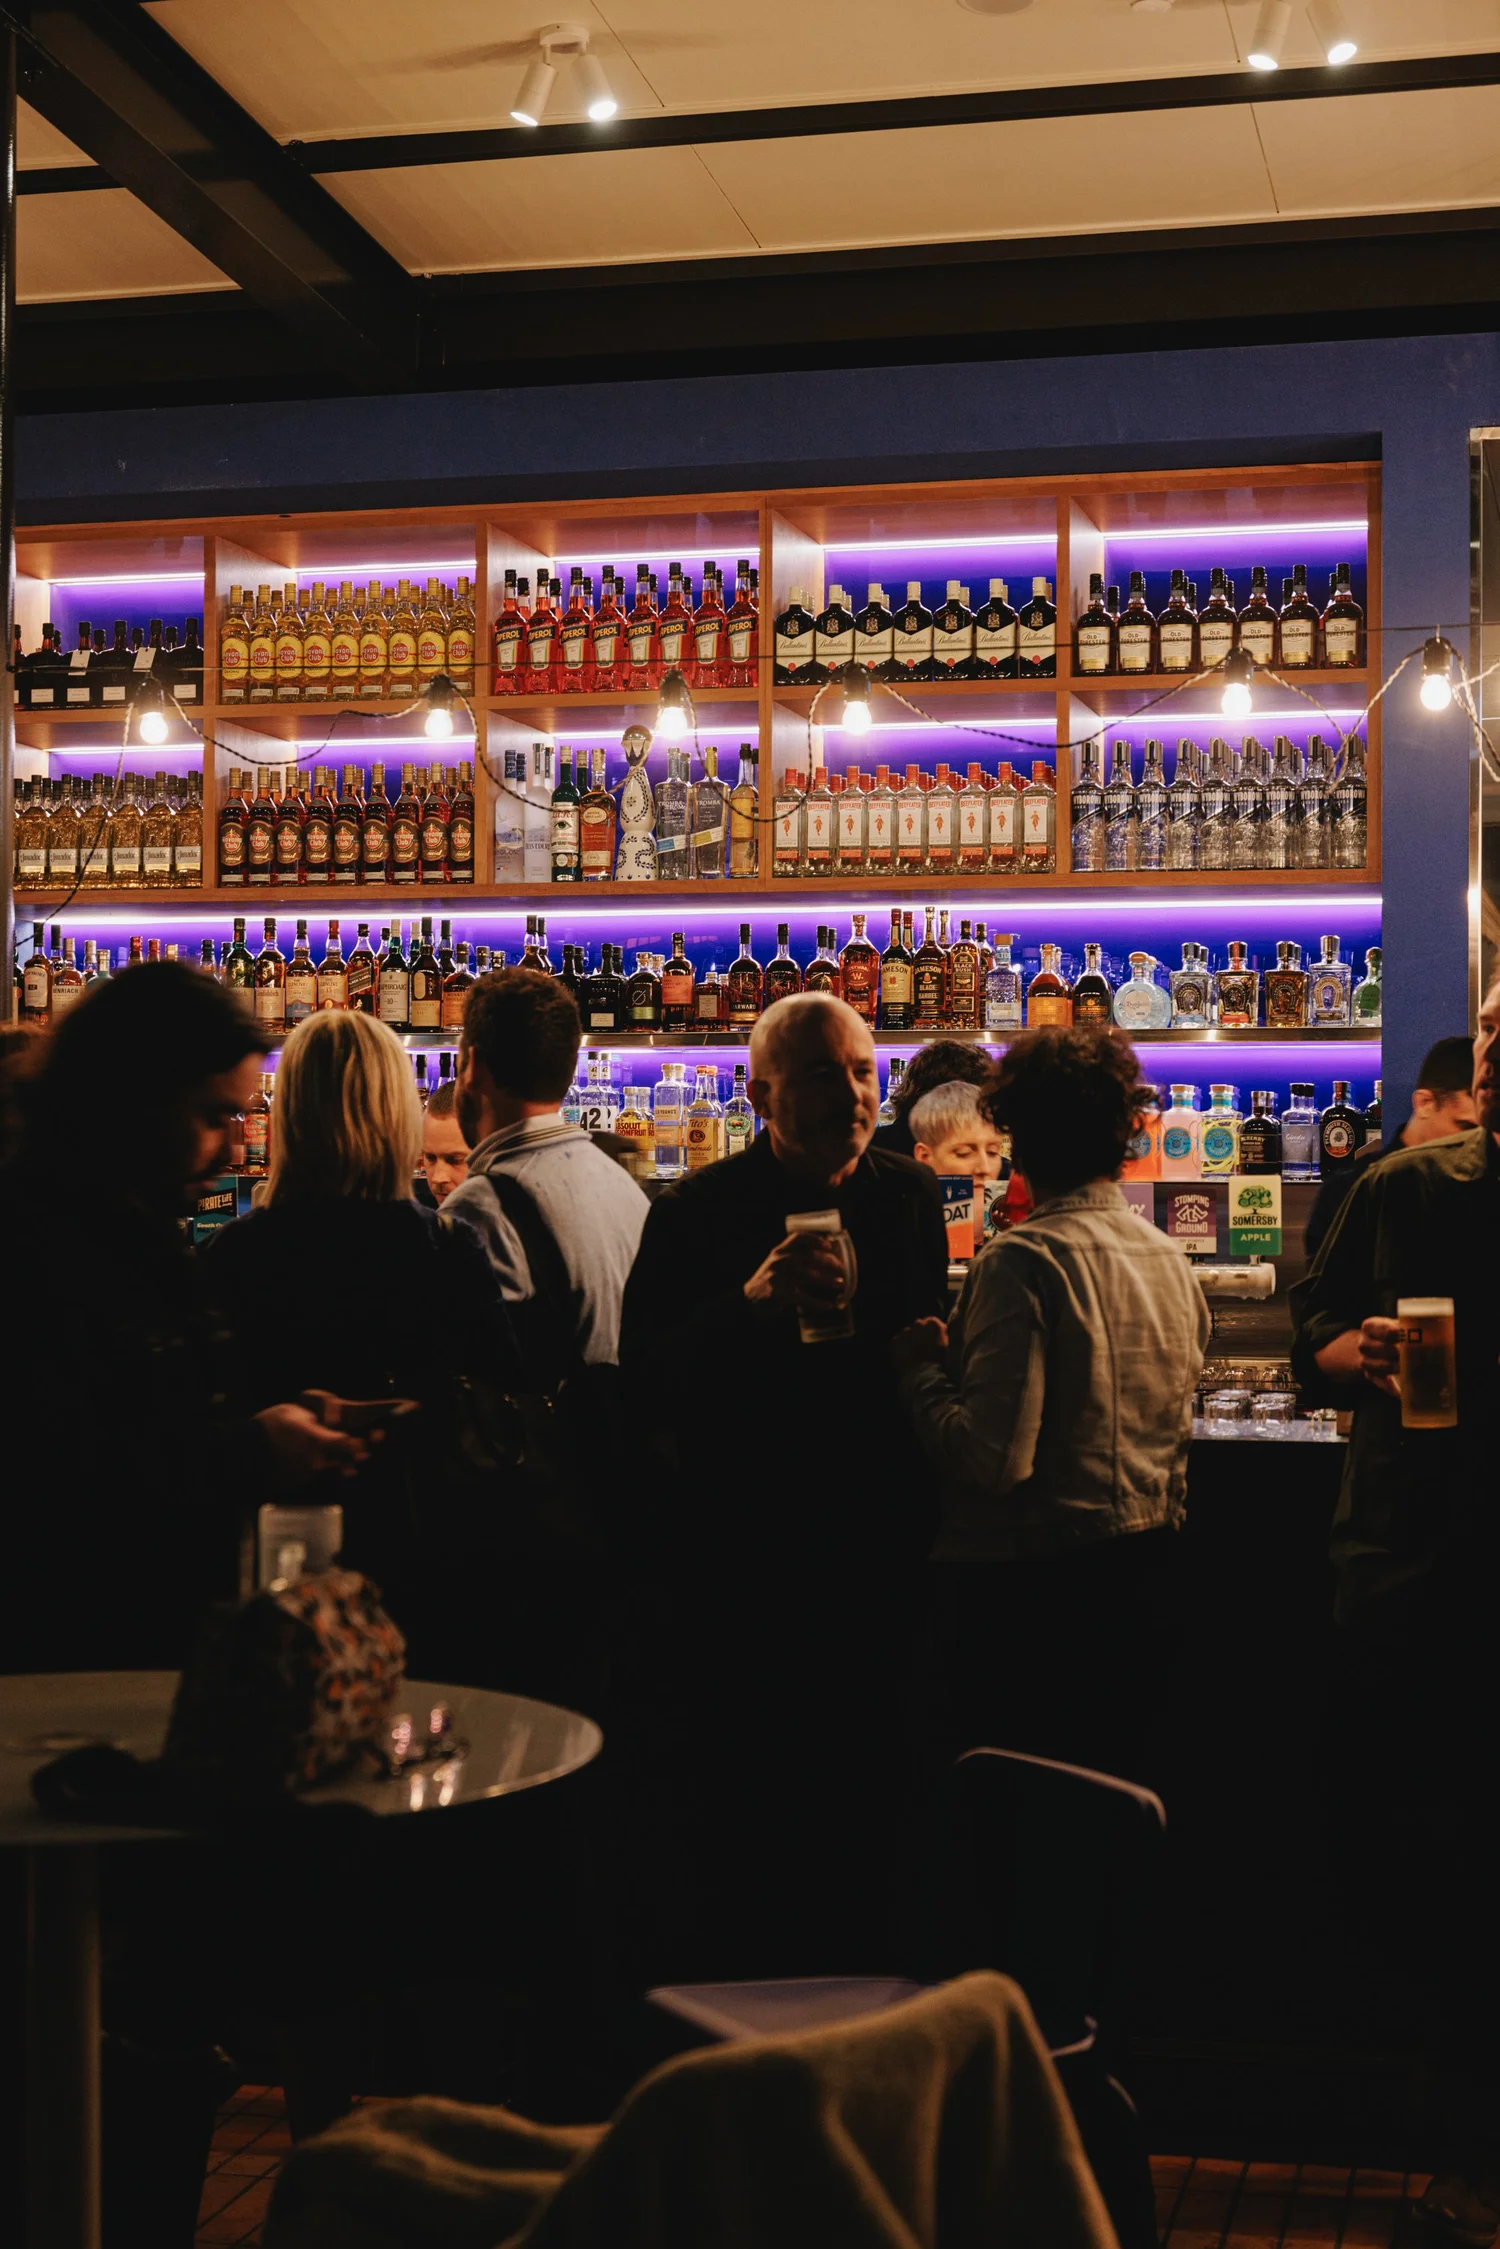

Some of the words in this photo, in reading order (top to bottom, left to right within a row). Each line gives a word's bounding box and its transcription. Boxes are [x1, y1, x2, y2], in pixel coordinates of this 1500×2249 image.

[594, 627, 618, 638] APEROL
[629, 625, 652, 636] APEROL
[661, 624, 684, 635] APEROL
[696, 622, 720, 634] APEROL
[728, 622, 752, 632] APEROL
[496, 630, 520, 640] APEROL
[529, 629, 552, 640] APEROL
[562, 628, 586, 639] APEROL
[580, 1108, 602, 1130] 42
[1174, 1194, 1210, 1208] STOMPING
[1232, 1216, 1278, 1226] SOMERSBY
[1176, 1222, 1208, 1234] GROUND
[1240, 1234, 1271, 1242] APPLE
